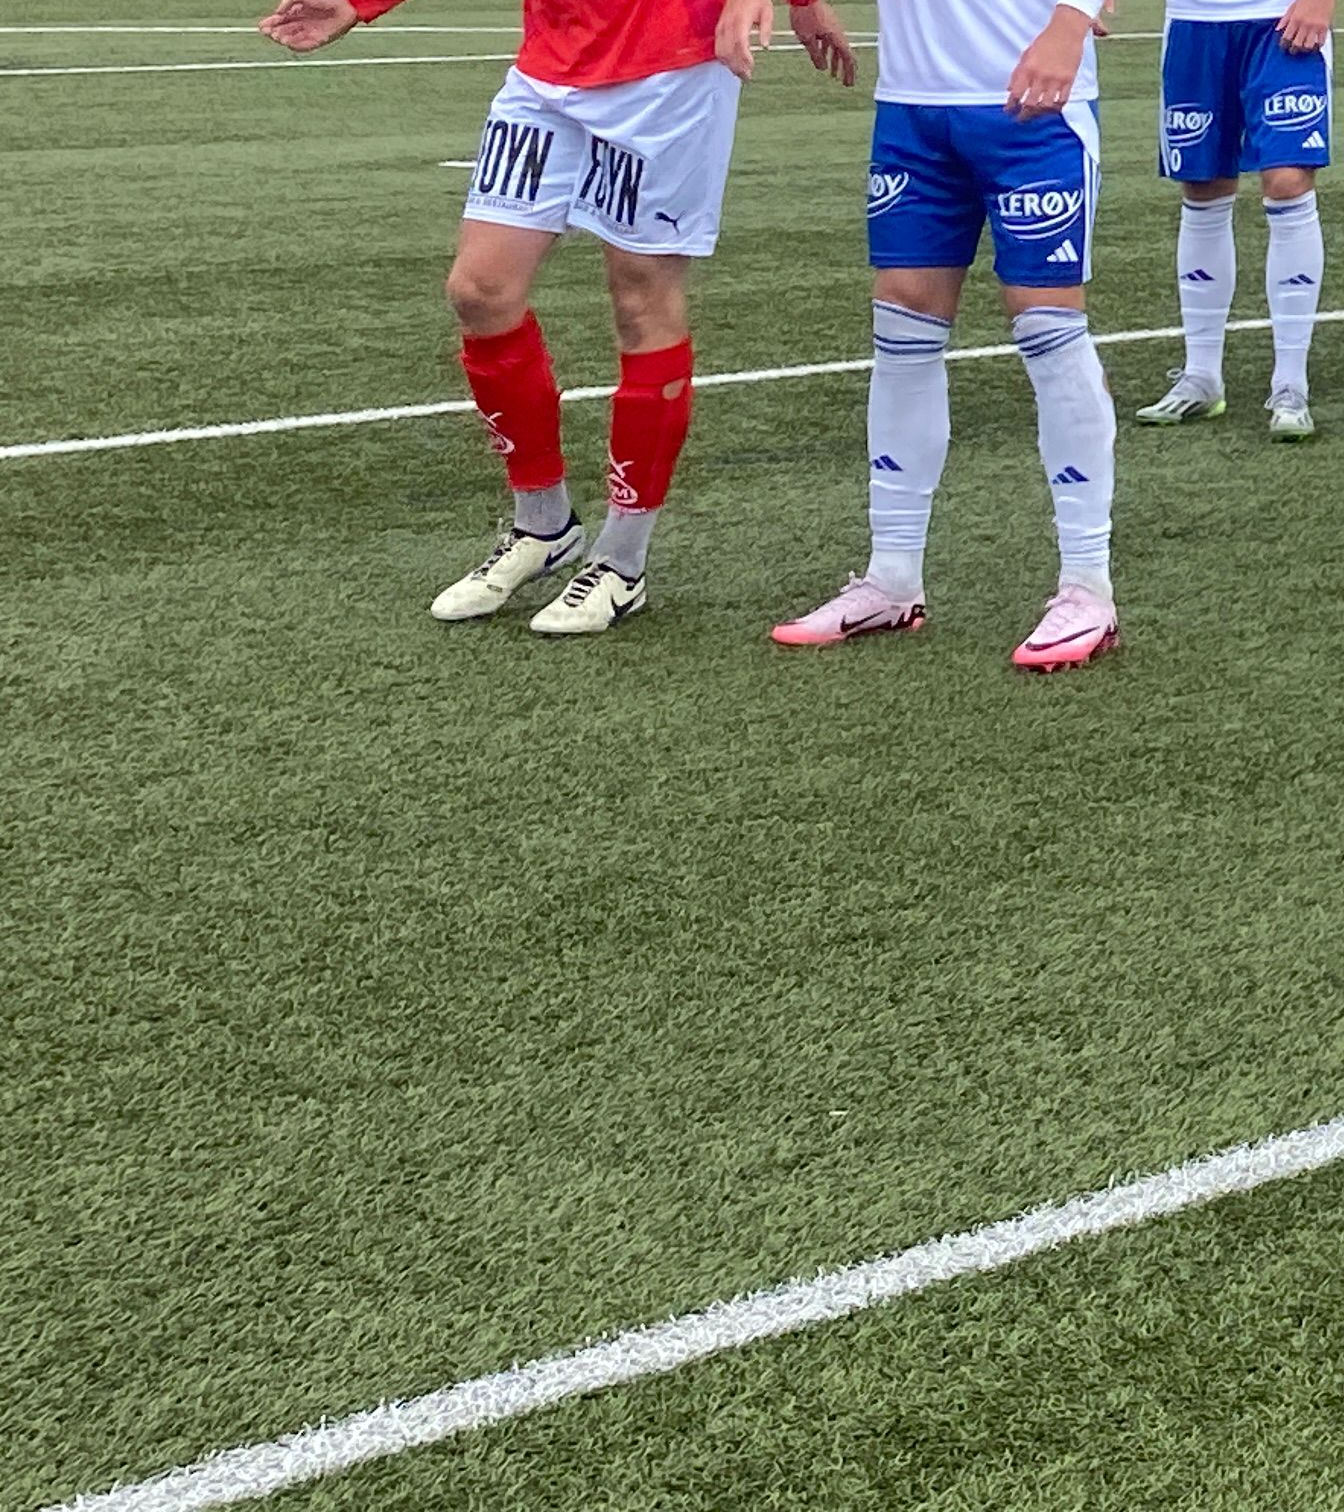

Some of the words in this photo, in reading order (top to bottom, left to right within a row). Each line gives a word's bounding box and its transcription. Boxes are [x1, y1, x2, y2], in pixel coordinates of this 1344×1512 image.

[1264, 93, 1327, 117] LERØY
[1165, 110, 1209, 131] ERØY
[474, 119, 555, 202] OYN
[997, 189, 1080, 218] LERØY
